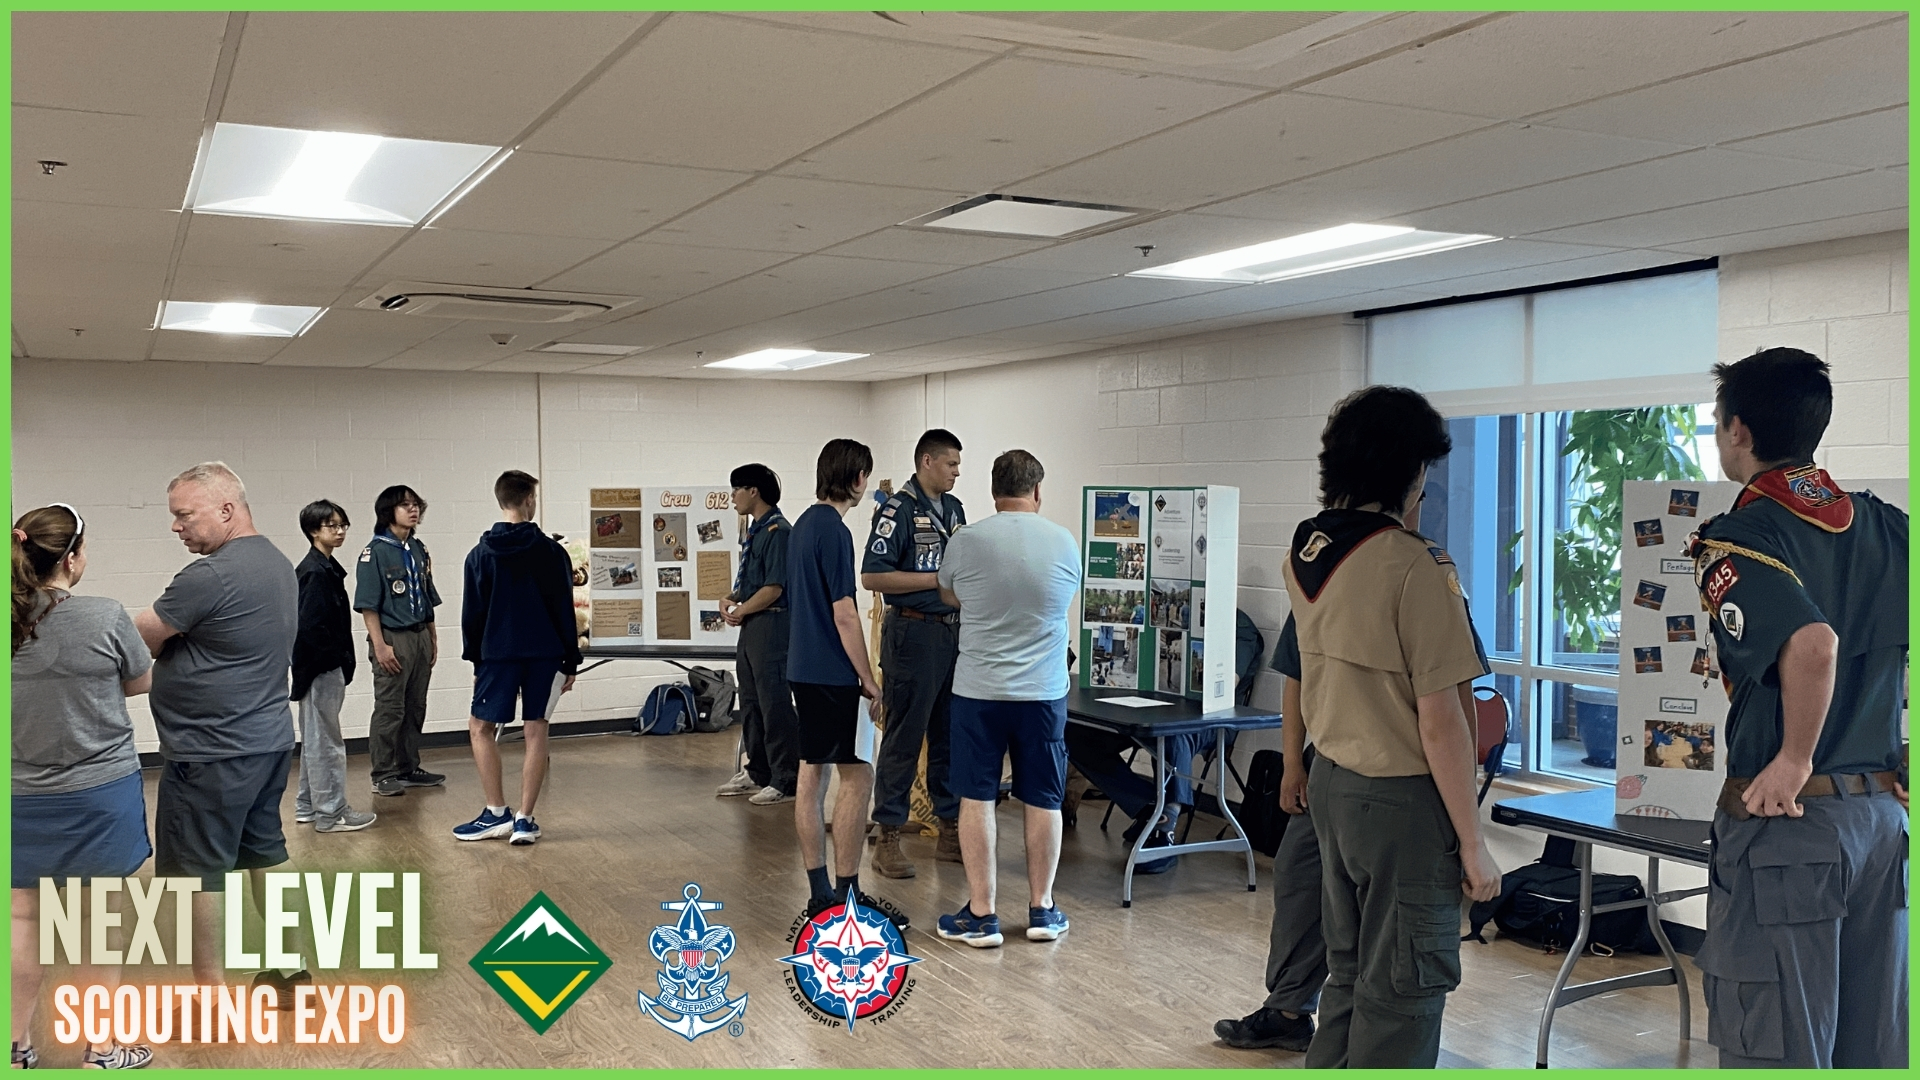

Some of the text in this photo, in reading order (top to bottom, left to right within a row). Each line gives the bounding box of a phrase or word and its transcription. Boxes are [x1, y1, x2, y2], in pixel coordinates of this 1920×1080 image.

[661, 490, 692, 507] Crew
[705, 491, 729, 510] 612
[1666, 562, 1695, 573] Pentago
[1707, 563, 1733, 602] 1345
